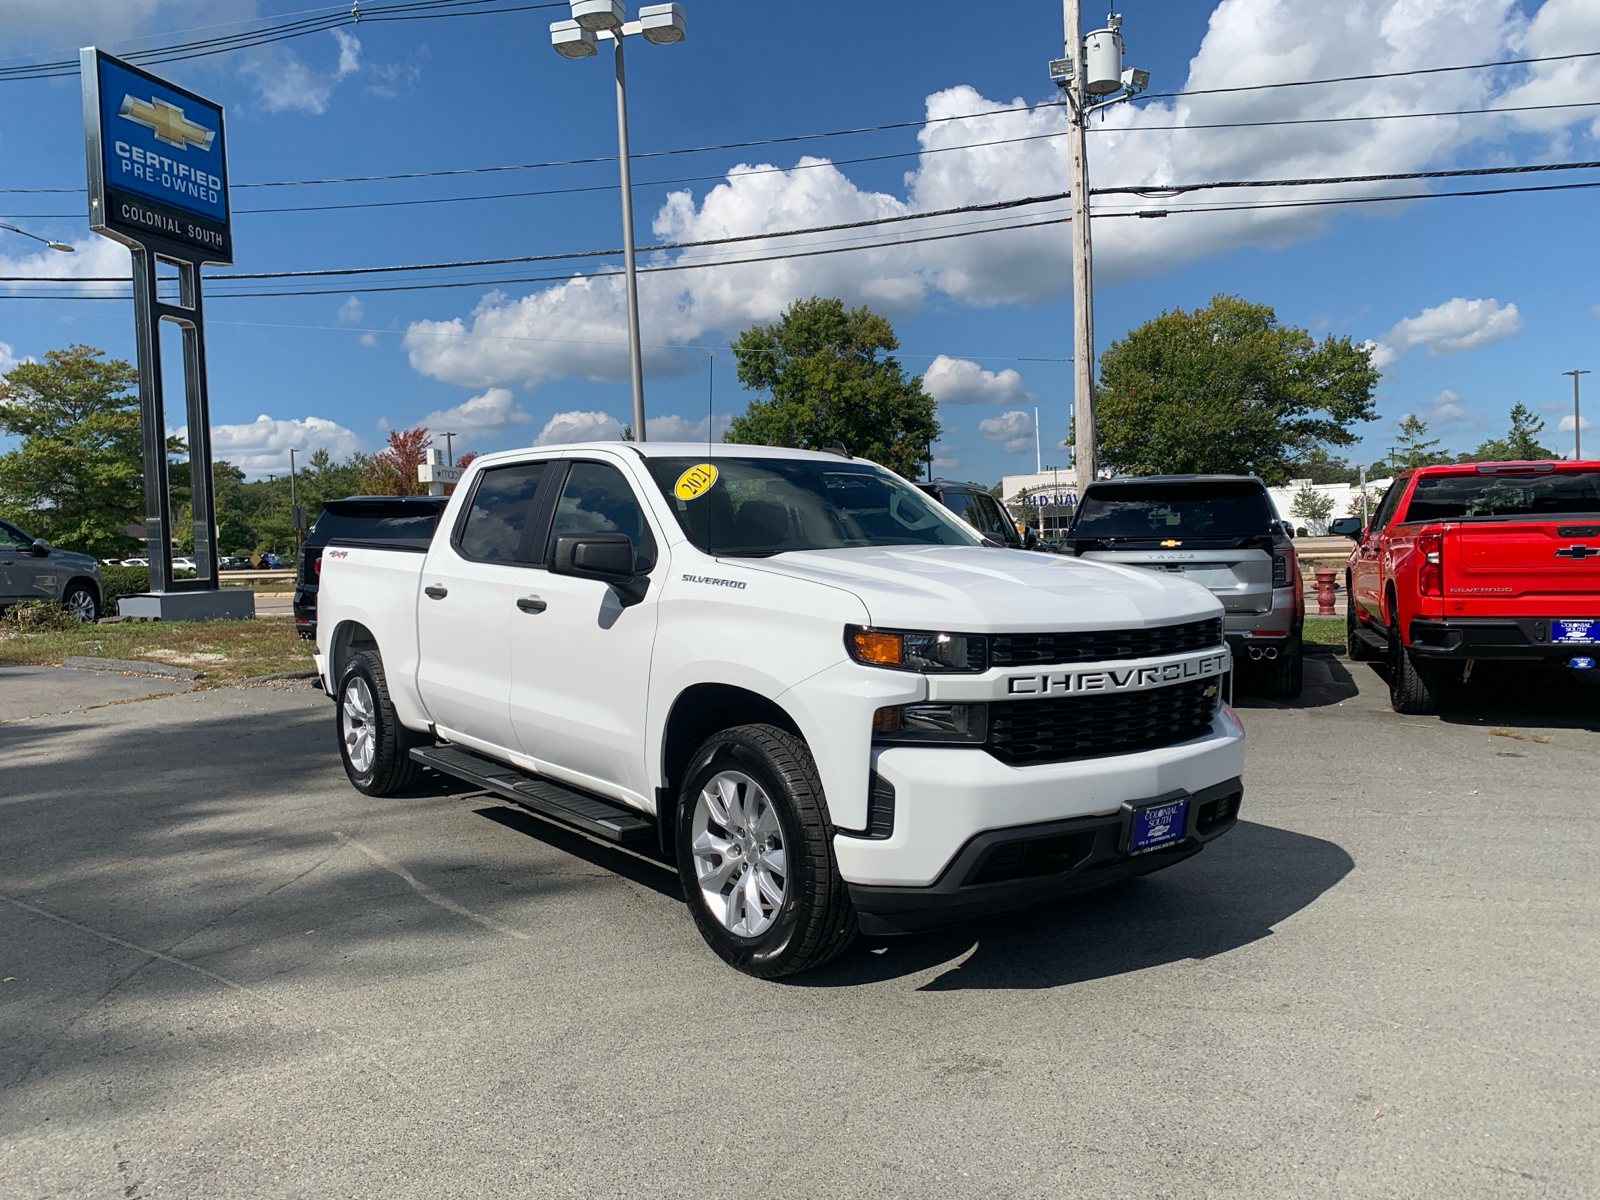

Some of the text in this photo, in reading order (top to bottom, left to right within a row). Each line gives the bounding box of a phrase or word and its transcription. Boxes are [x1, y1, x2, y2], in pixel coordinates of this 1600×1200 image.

[115, 141, 221, 190] CERTIFIED
[122, 159, 218, 204] PRE-OWNED
[122, 204, 223, 246] COLONIAL SOUTH
[682, 467, 711, 495] 2021
[1022, 495, 1049, 507] OLD
[681, 574, 748, 590] SILVERADO
[1008, 655, 1227, 696] CHEVROLET
[1145, 806, 1178, 820] COLONIAL
[1148, 815, 1172, 828] SOUTH
